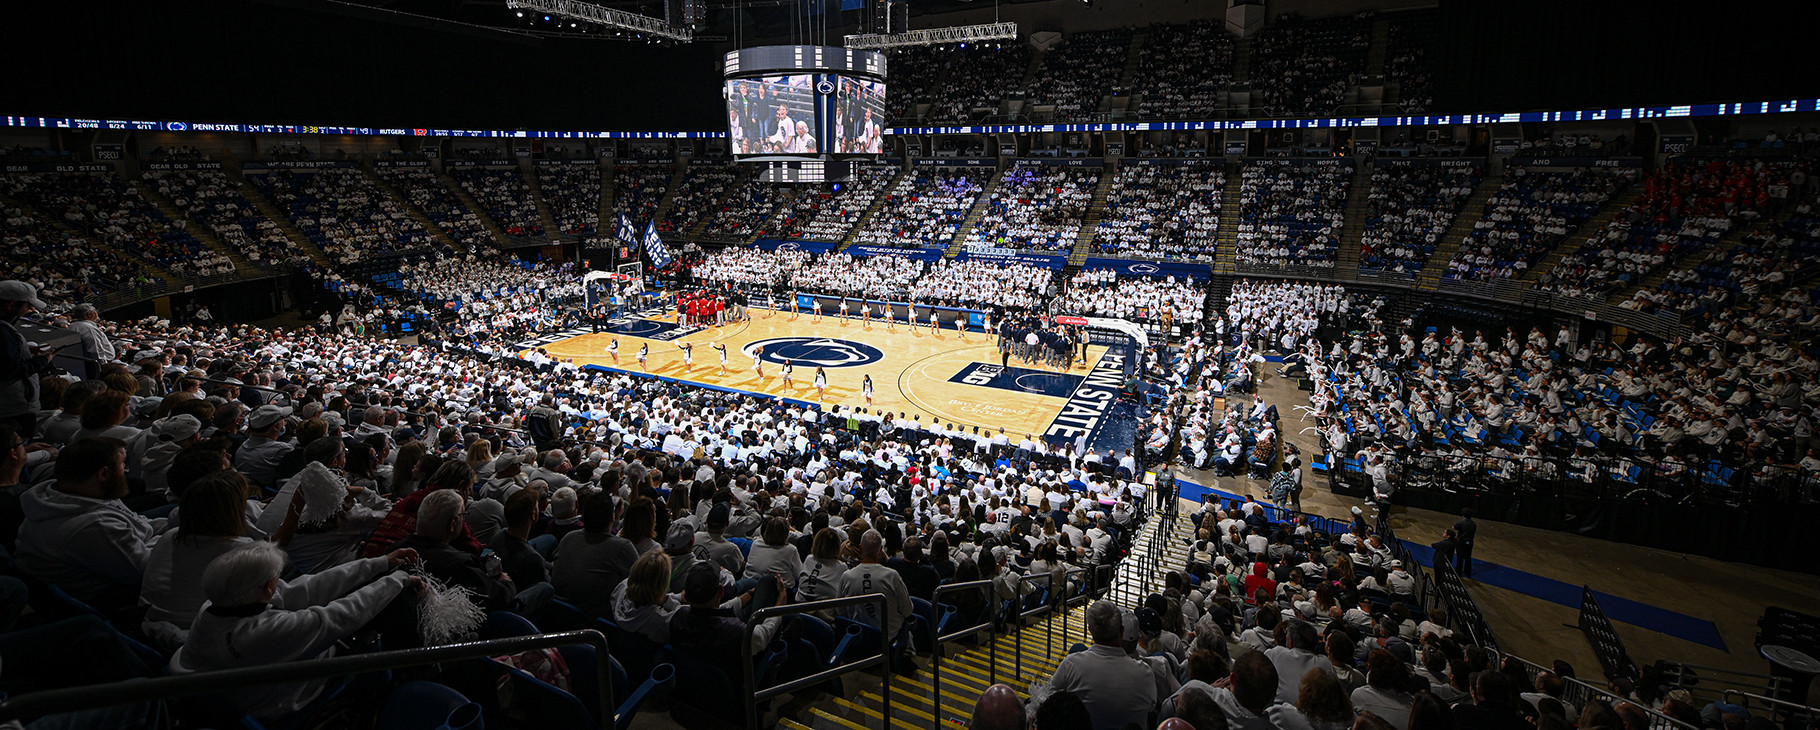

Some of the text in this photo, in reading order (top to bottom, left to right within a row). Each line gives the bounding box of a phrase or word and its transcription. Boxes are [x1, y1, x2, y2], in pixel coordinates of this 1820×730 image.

[192, 123, 239, 132] PENN STATE
[248, 124, 259, 132] 54
[302, 125, 319, 133] 3:38
[1084, 354, 1127, 389] PENN
[948, 400, 1027, 416] BRYCE JORDAN
[960, 407, 1003, 418] CENTER
[1046, 388, 1114, 440] STATE
[997, 512, 1009, 524] 12
